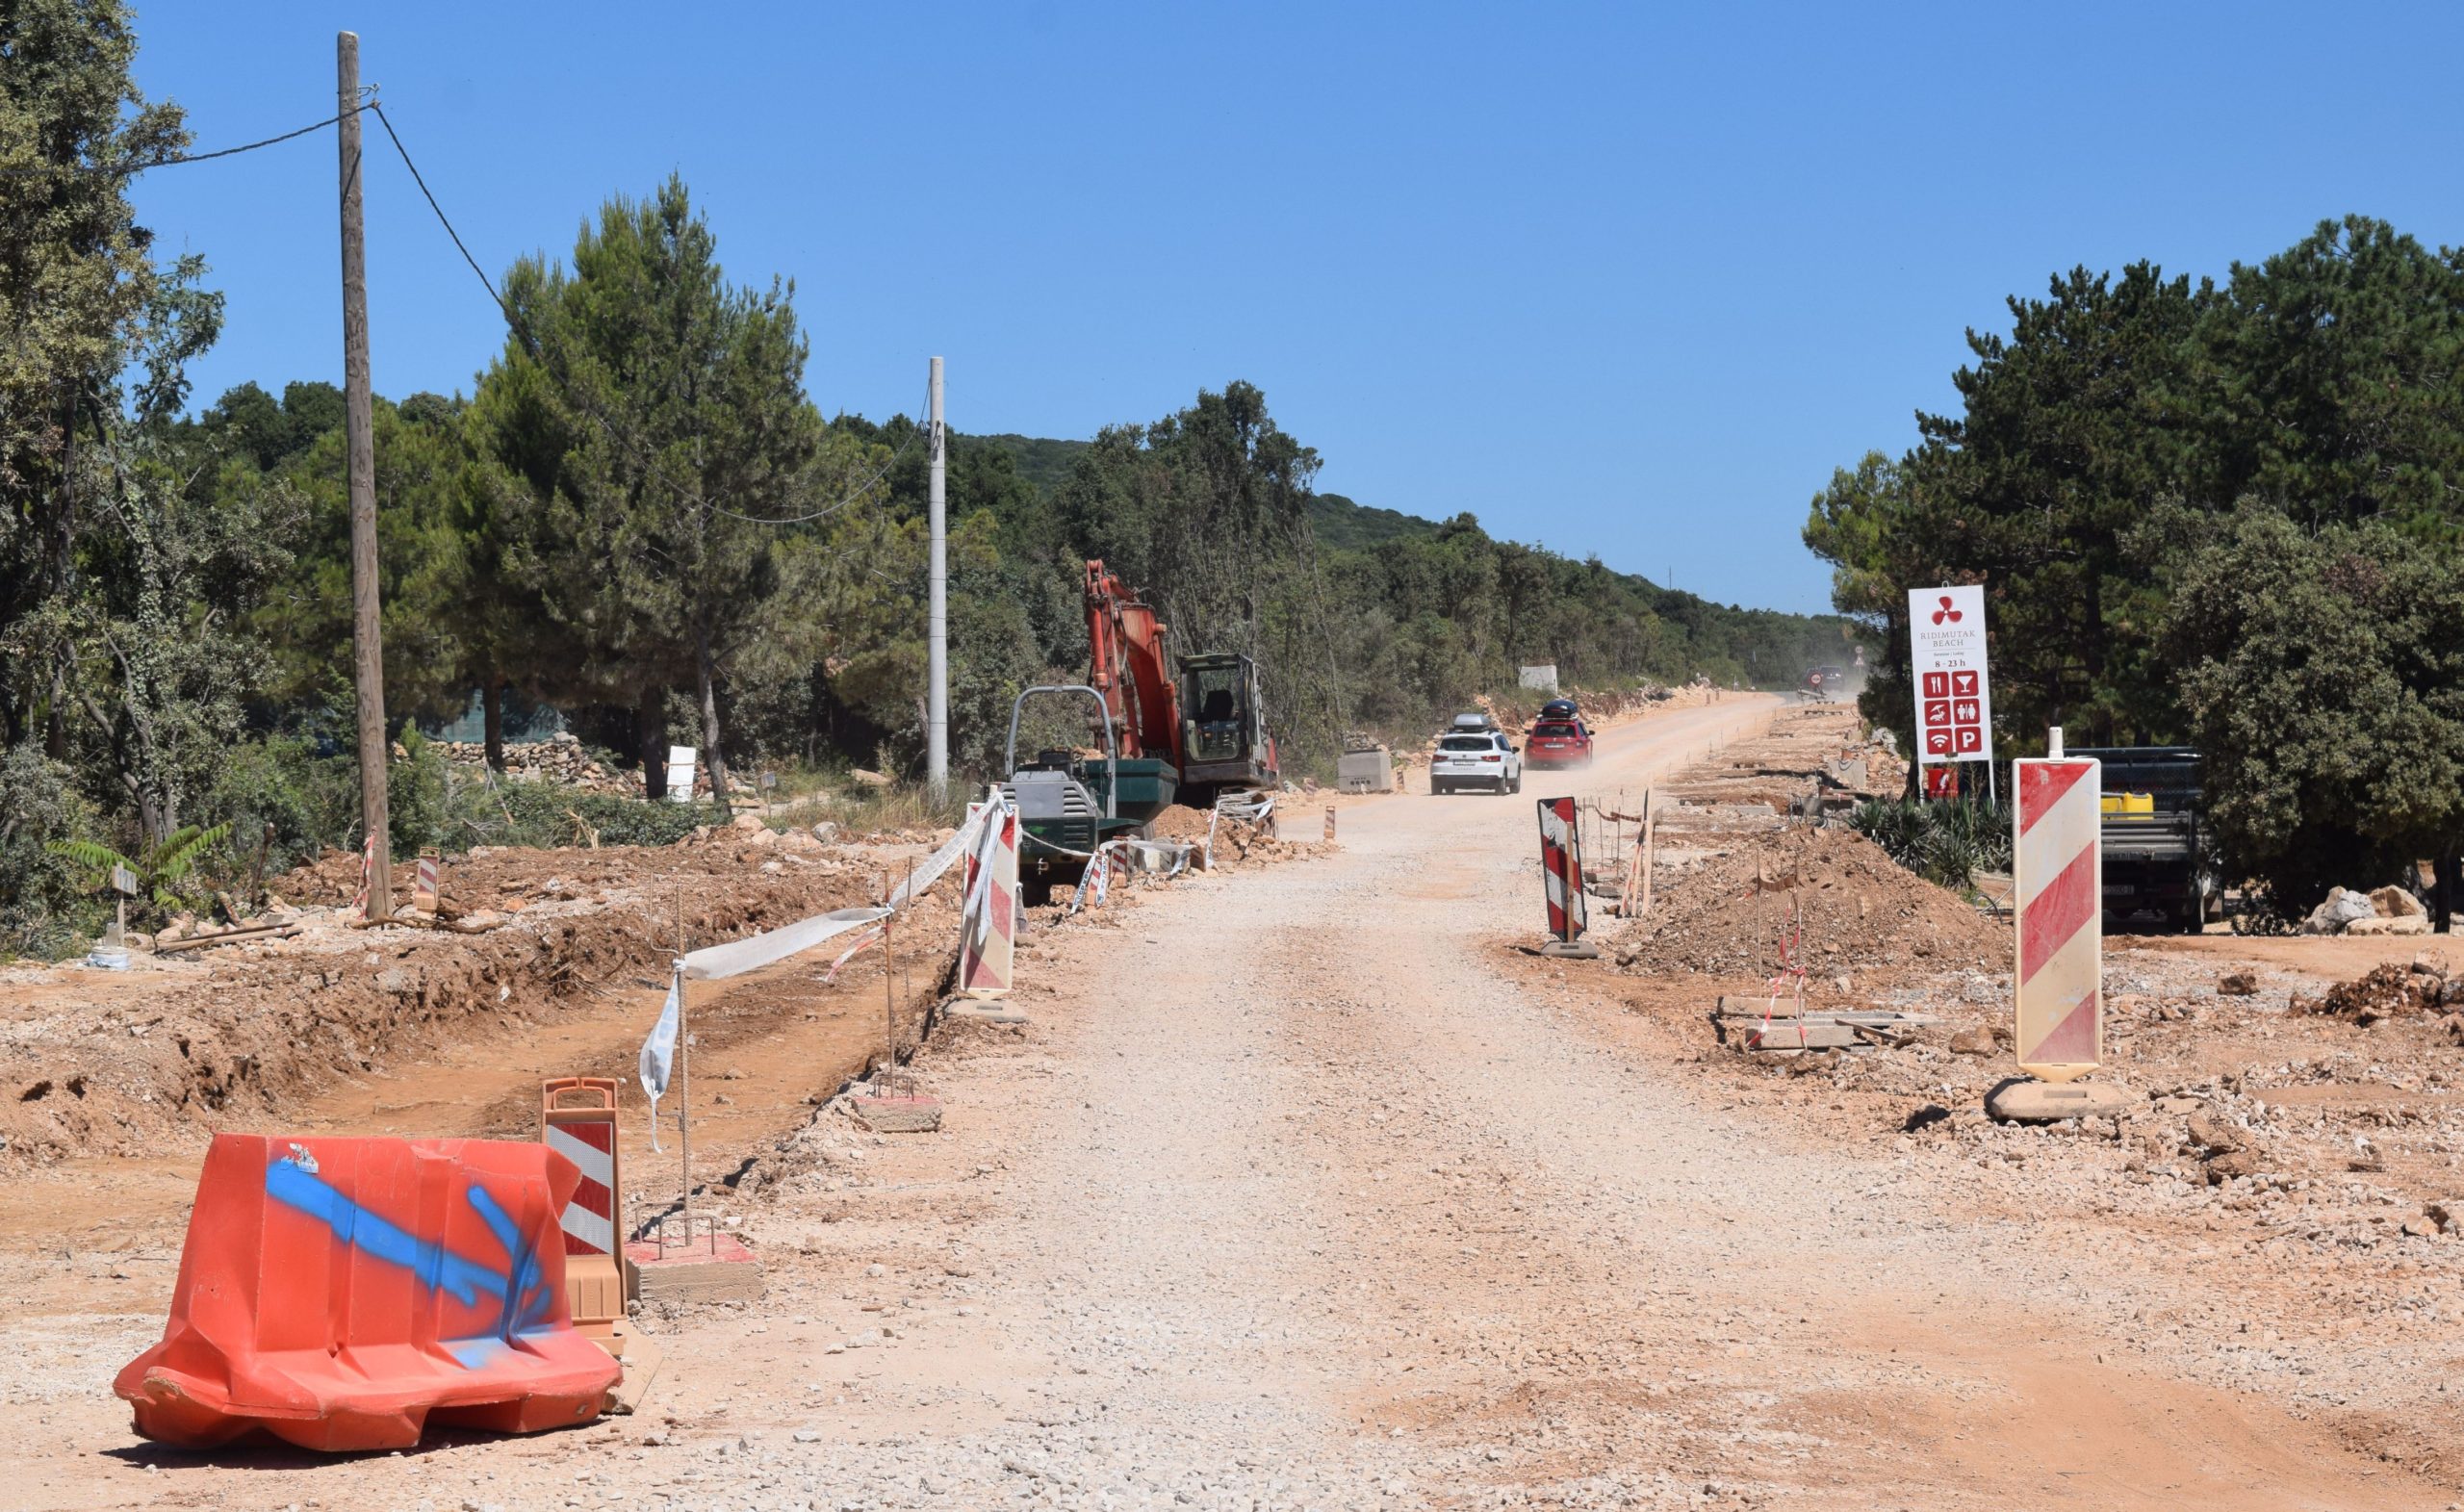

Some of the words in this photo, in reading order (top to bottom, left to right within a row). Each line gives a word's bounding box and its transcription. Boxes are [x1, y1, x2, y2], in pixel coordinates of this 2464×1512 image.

[1920, 630, 1976, 640] RIDIMUTAK
[1963, 731, 1975, 748] P
[117, 869, 134, 892] 121
